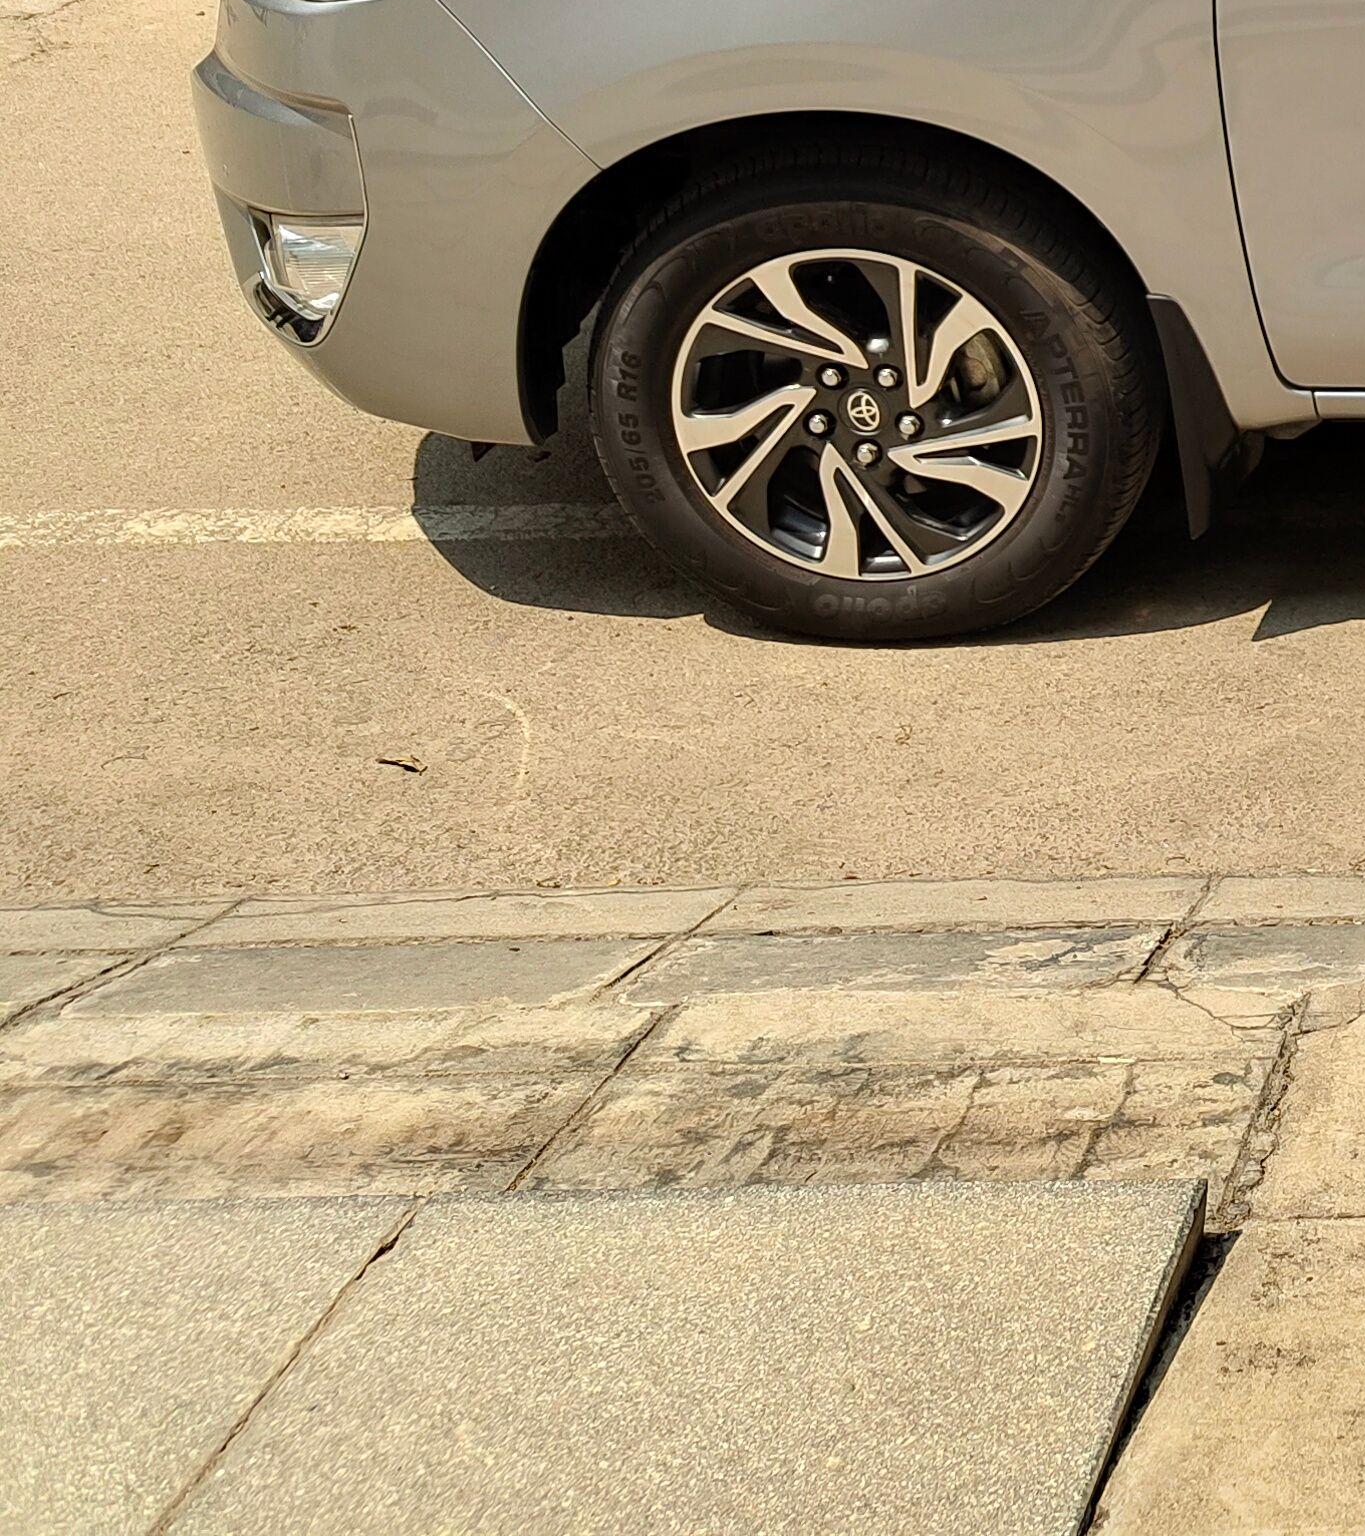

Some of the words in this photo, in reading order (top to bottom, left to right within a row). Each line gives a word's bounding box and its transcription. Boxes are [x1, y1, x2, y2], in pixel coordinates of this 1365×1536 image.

[616, 350, 642, 402] R16
[1019, 309, 1091, 480] APTERRA
[617, 411, 666, 505] 205/65
[813, 584, 948, 622] apollo
